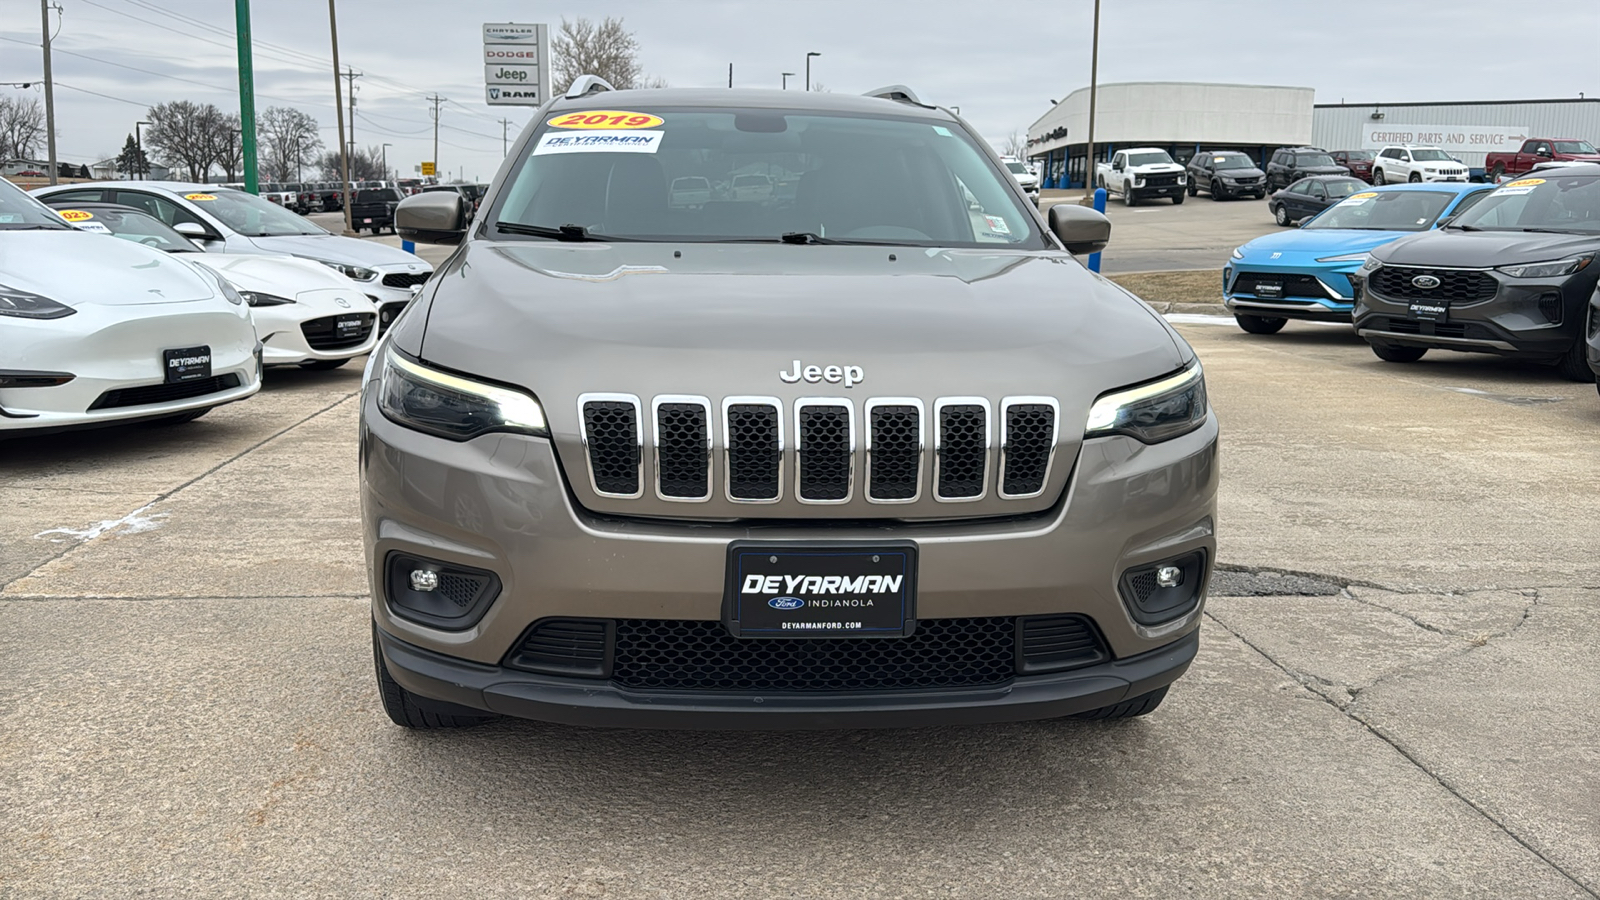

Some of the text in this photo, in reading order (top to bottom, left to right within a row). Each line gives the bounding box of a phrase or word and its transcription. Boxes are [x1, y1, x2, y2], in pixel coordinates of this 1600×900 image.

[495, 67, 527, 81] Jeep
[557, 114, 652, 126] 2019
[546, 136, 654, 145] DEYARMAN
[1370, 131, 1504, 145] CERTIFIED PARTS AND SERVICE
[62, 211, 90, 220] 023
[169, 355, 210, 367] DEYARMAN
[779, 360, 864, 388] Jeep
[741, 574, 903, 594] DEYARMAN
[808, 599, 874, 607] INDIANOLA
